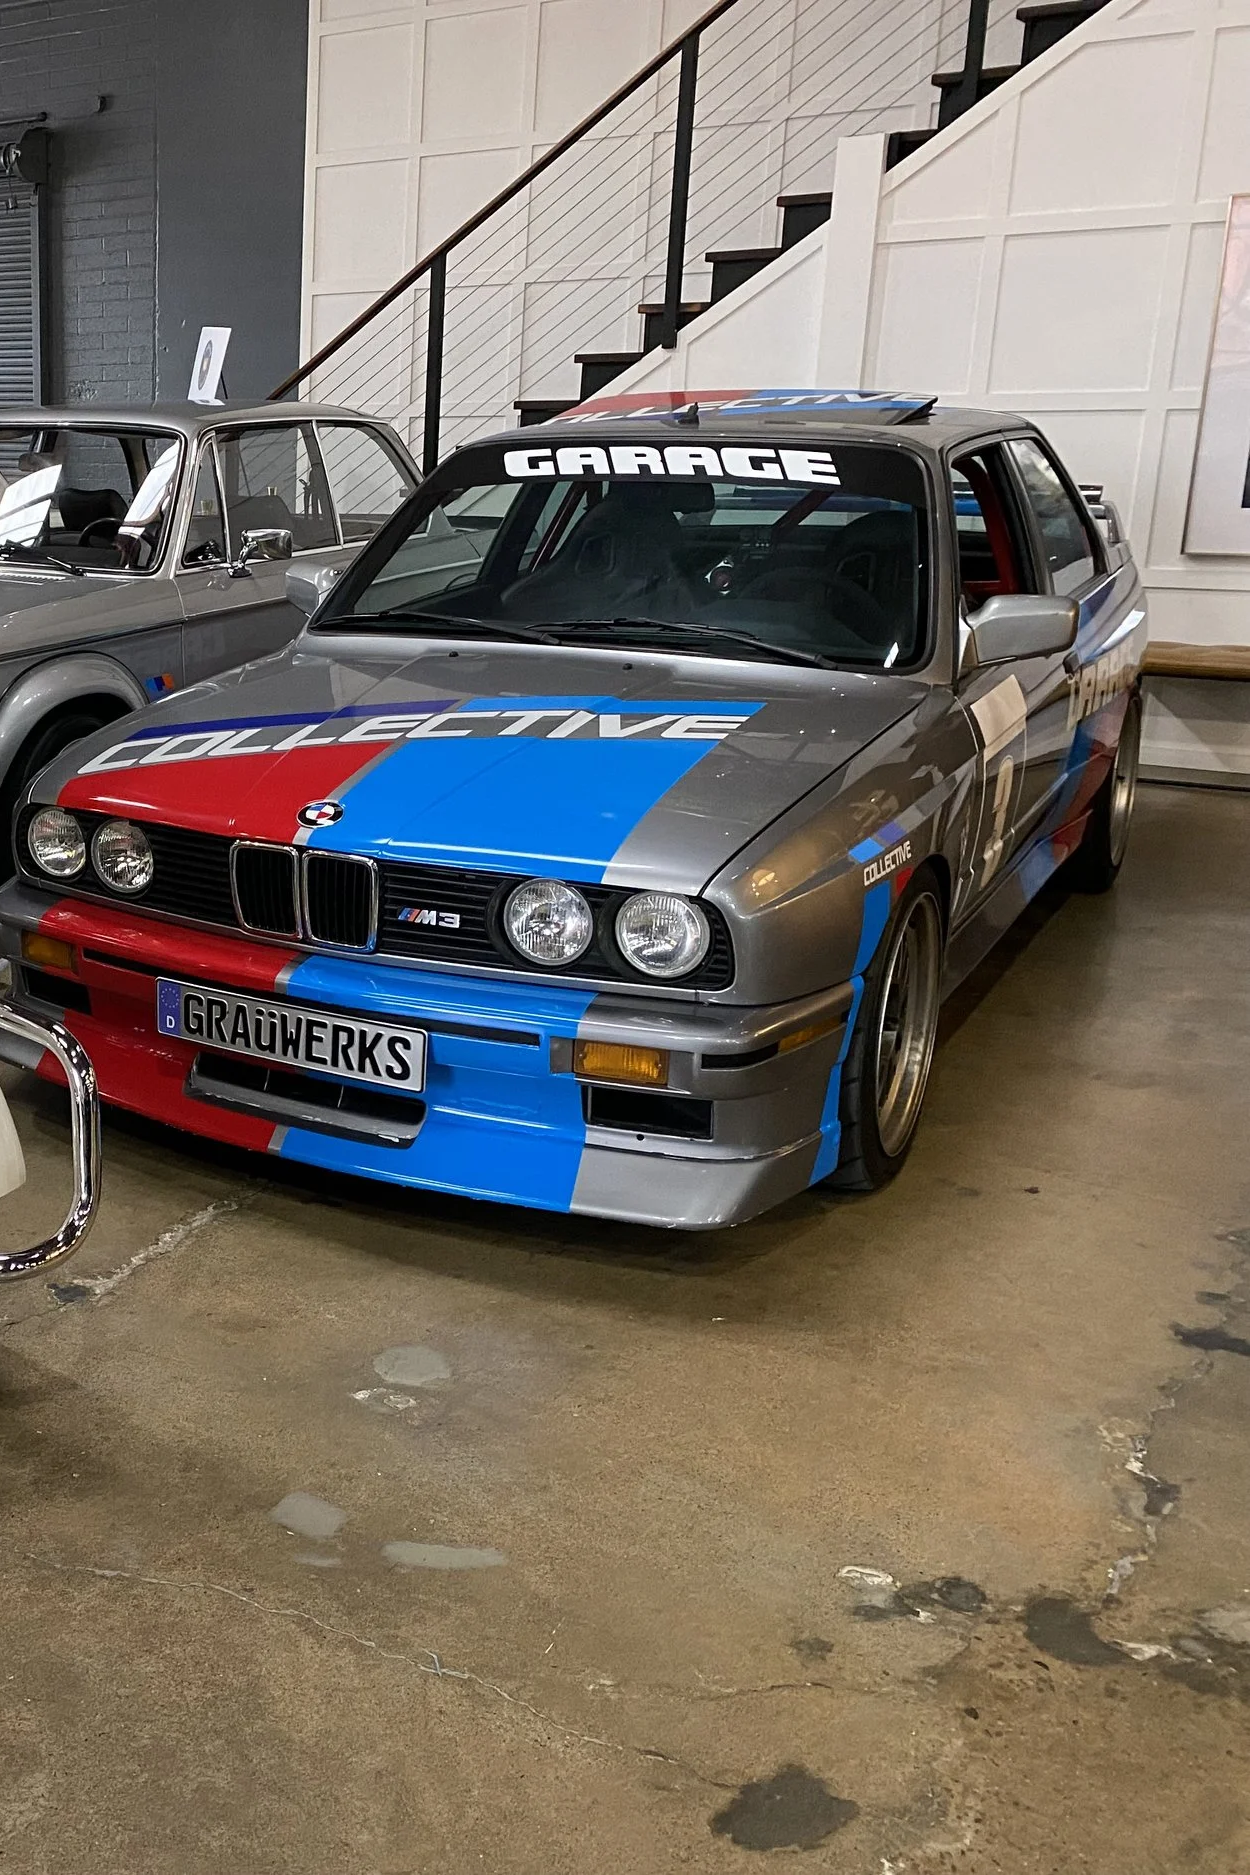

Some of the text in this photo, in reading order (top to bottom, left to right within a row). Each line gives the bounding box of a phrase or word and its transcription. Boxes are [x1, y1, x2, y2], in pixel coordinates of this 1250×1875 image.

[536, 392, 937, 427] OLLECTIVE
[504, 446, 841, 485] GARAGE
[77, 709, 750, 775] COLLECTIVE
[863, 840, 912, 887] COLLECTIVE
[166, 1015, 176, 1029] D
